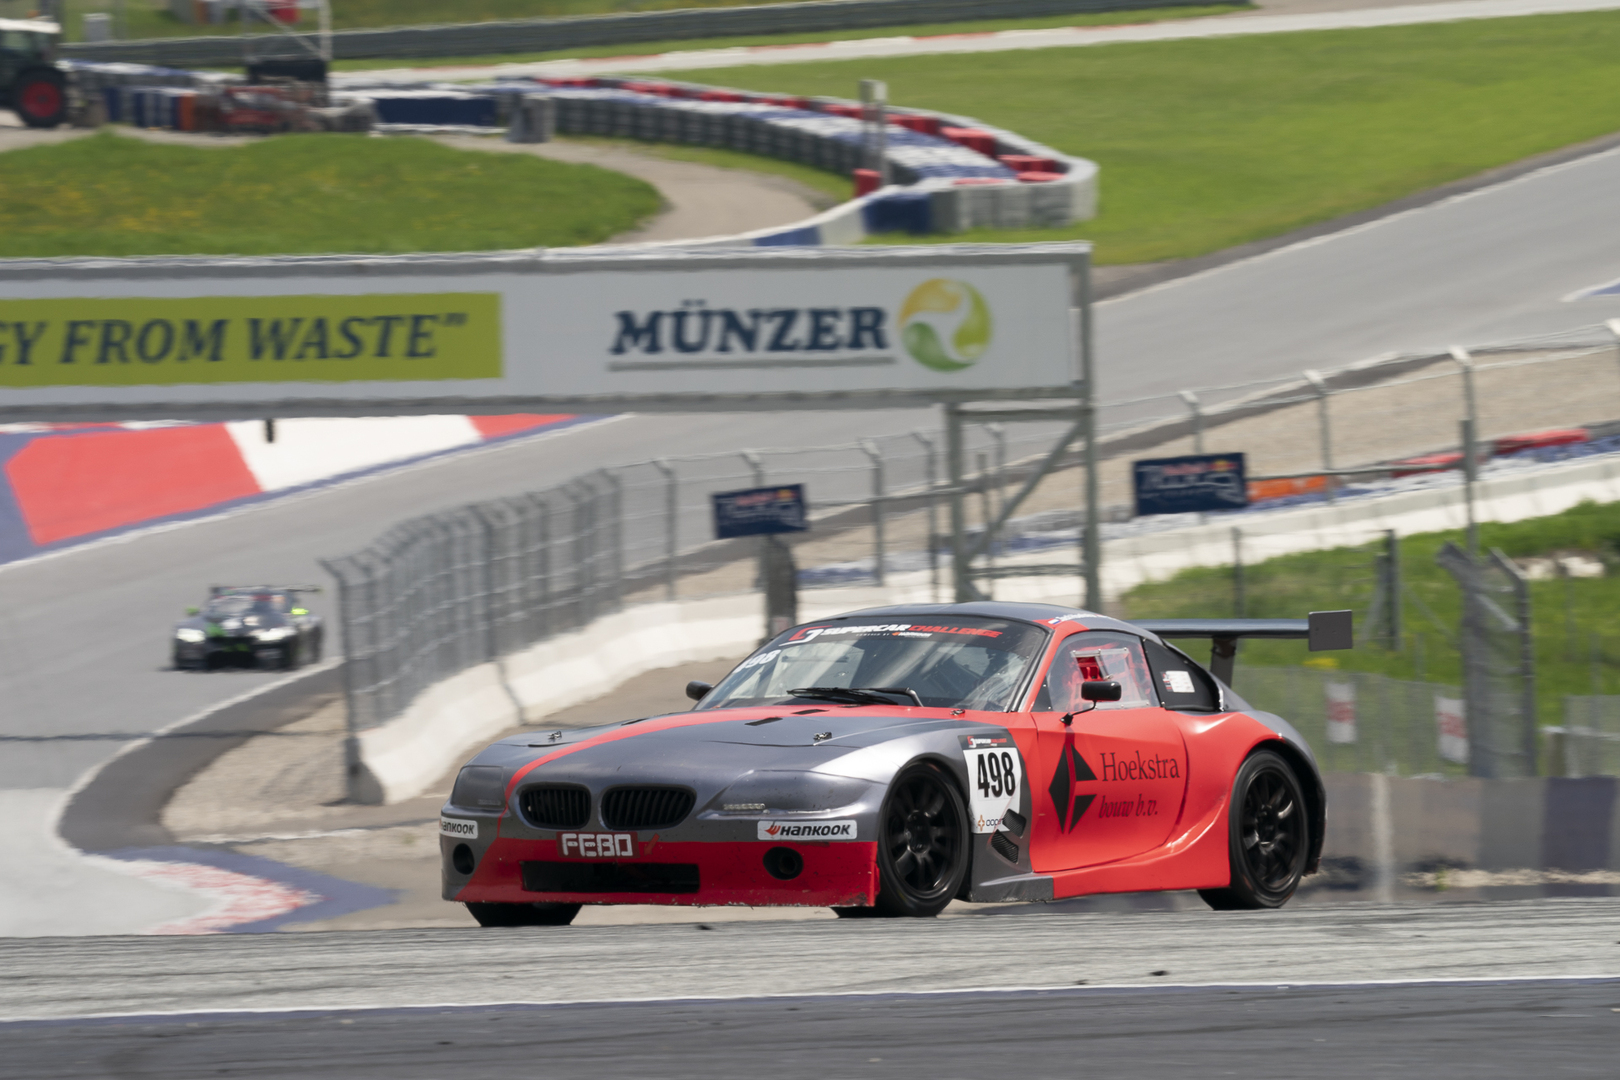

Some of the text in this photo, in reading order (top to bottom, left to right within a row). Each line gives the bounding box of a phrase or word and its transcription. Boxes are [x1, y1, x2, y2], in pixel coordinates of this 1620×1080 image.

[59, 318, 231, 364] FROM
[609, 299, 890, 355] MÜNZER
[820, 624, 911, 635] SUPERCAR
[908, 625, 1003, 638] CHALLENGE
[977, 751, 1016, 798] 498
[1100, 750, 1181, 781] Hoekstra
[1098, 793, 1158, 819] bouw b.v.
[561, 833, 634, 857] FEBO
